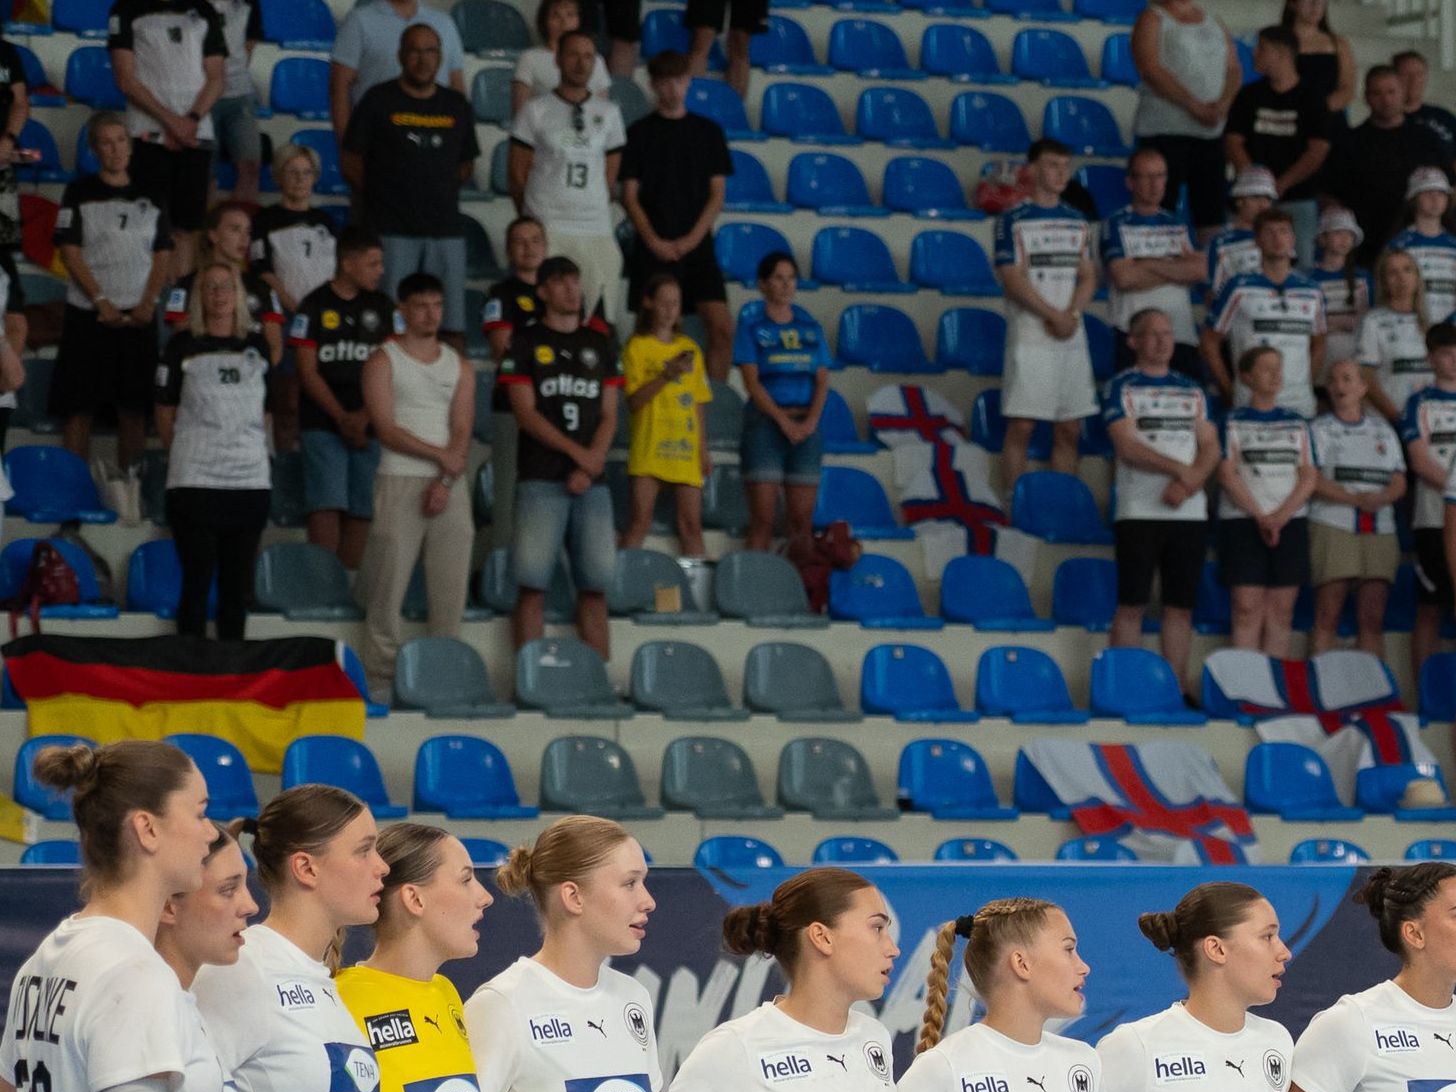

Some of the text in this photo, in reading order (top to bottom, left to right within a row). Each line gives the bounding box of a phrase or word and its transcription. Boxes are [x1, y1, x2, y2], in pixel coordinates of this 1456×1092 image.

[566, 162, 589, 189] 13
[540, 373, 600, 399] atlas
[276, 984, 315, 1007] hella
[367, 1017, 415, 1045] hella
[529, 1017, 573, 1041] hella
[1376, 1029, 1420, 1050] hella
[353, 1060, 375, 1080] TENA
[761, 1055, 812, 1079] hella
[1155, 1056, 1207, 1079] hella
